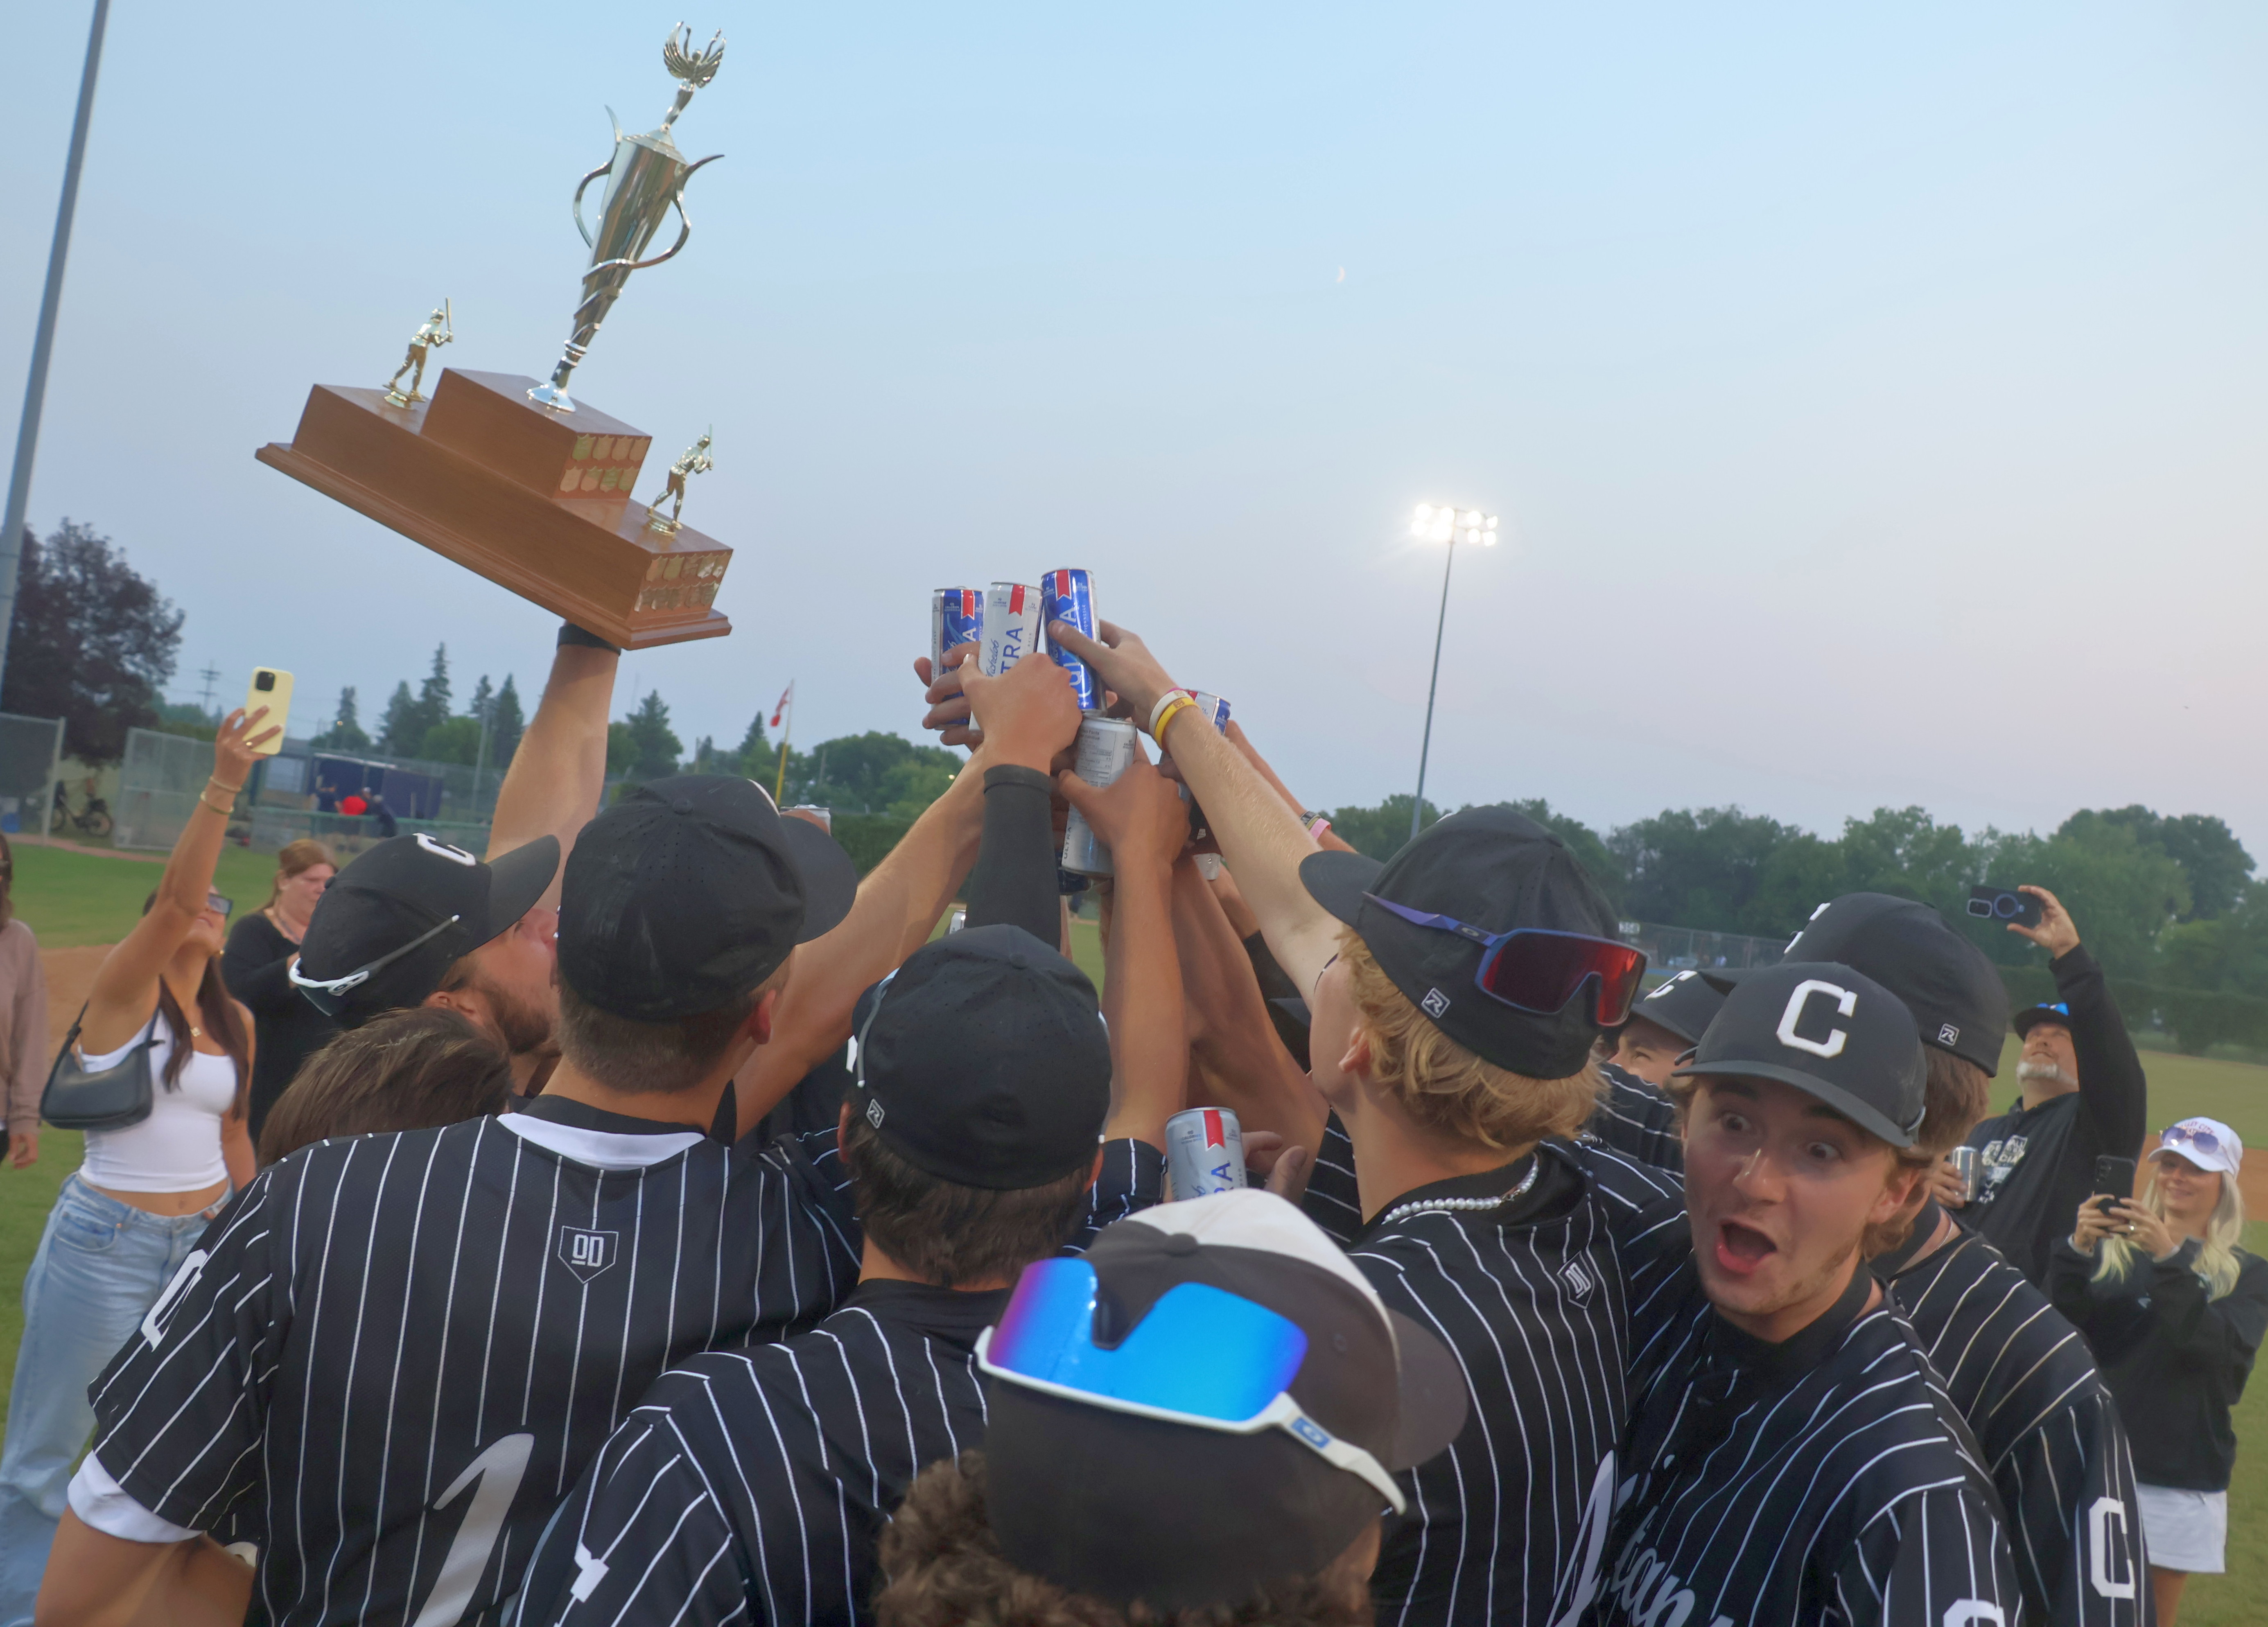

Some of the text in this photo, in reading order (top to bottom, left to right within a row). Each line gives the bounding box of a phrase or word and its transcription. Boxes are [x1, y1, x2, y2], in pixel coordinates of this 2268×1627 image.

[1000, 627, 1023, 674] TRA
[1776, 979, 1857, 1059] C
[2088, 1496, 2136, 1600] C
